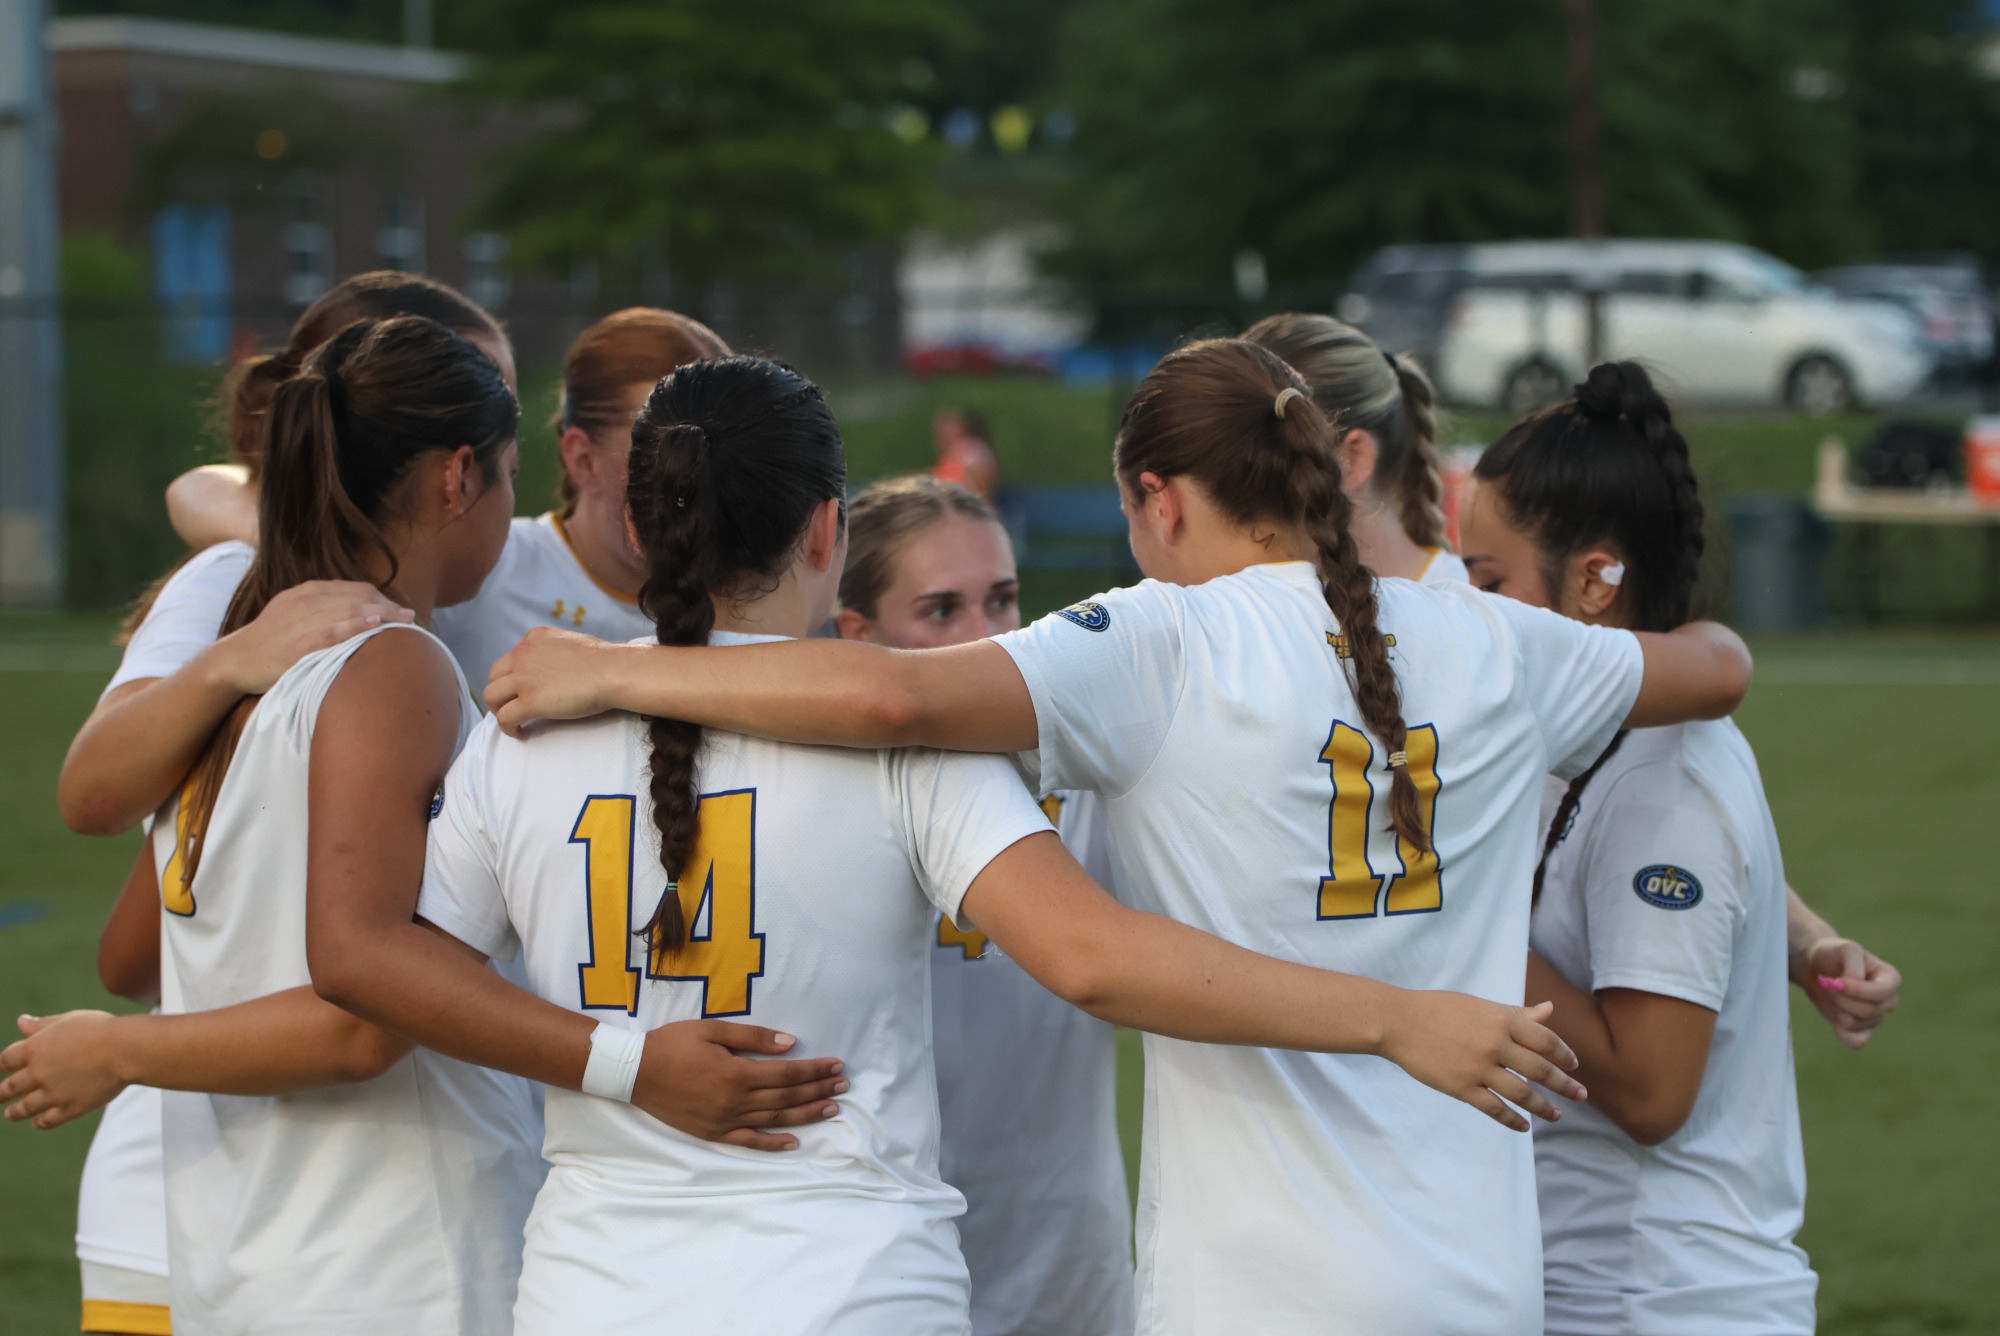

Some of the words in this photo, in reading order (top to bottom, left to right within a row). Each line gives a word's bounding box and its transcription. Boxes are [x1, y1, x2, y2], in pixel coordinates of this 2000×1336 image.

[567, 787, 766, 1019] 14
[1316, 719, 1444, 921] 11
[1646, 876, 1689, 900] OVC
